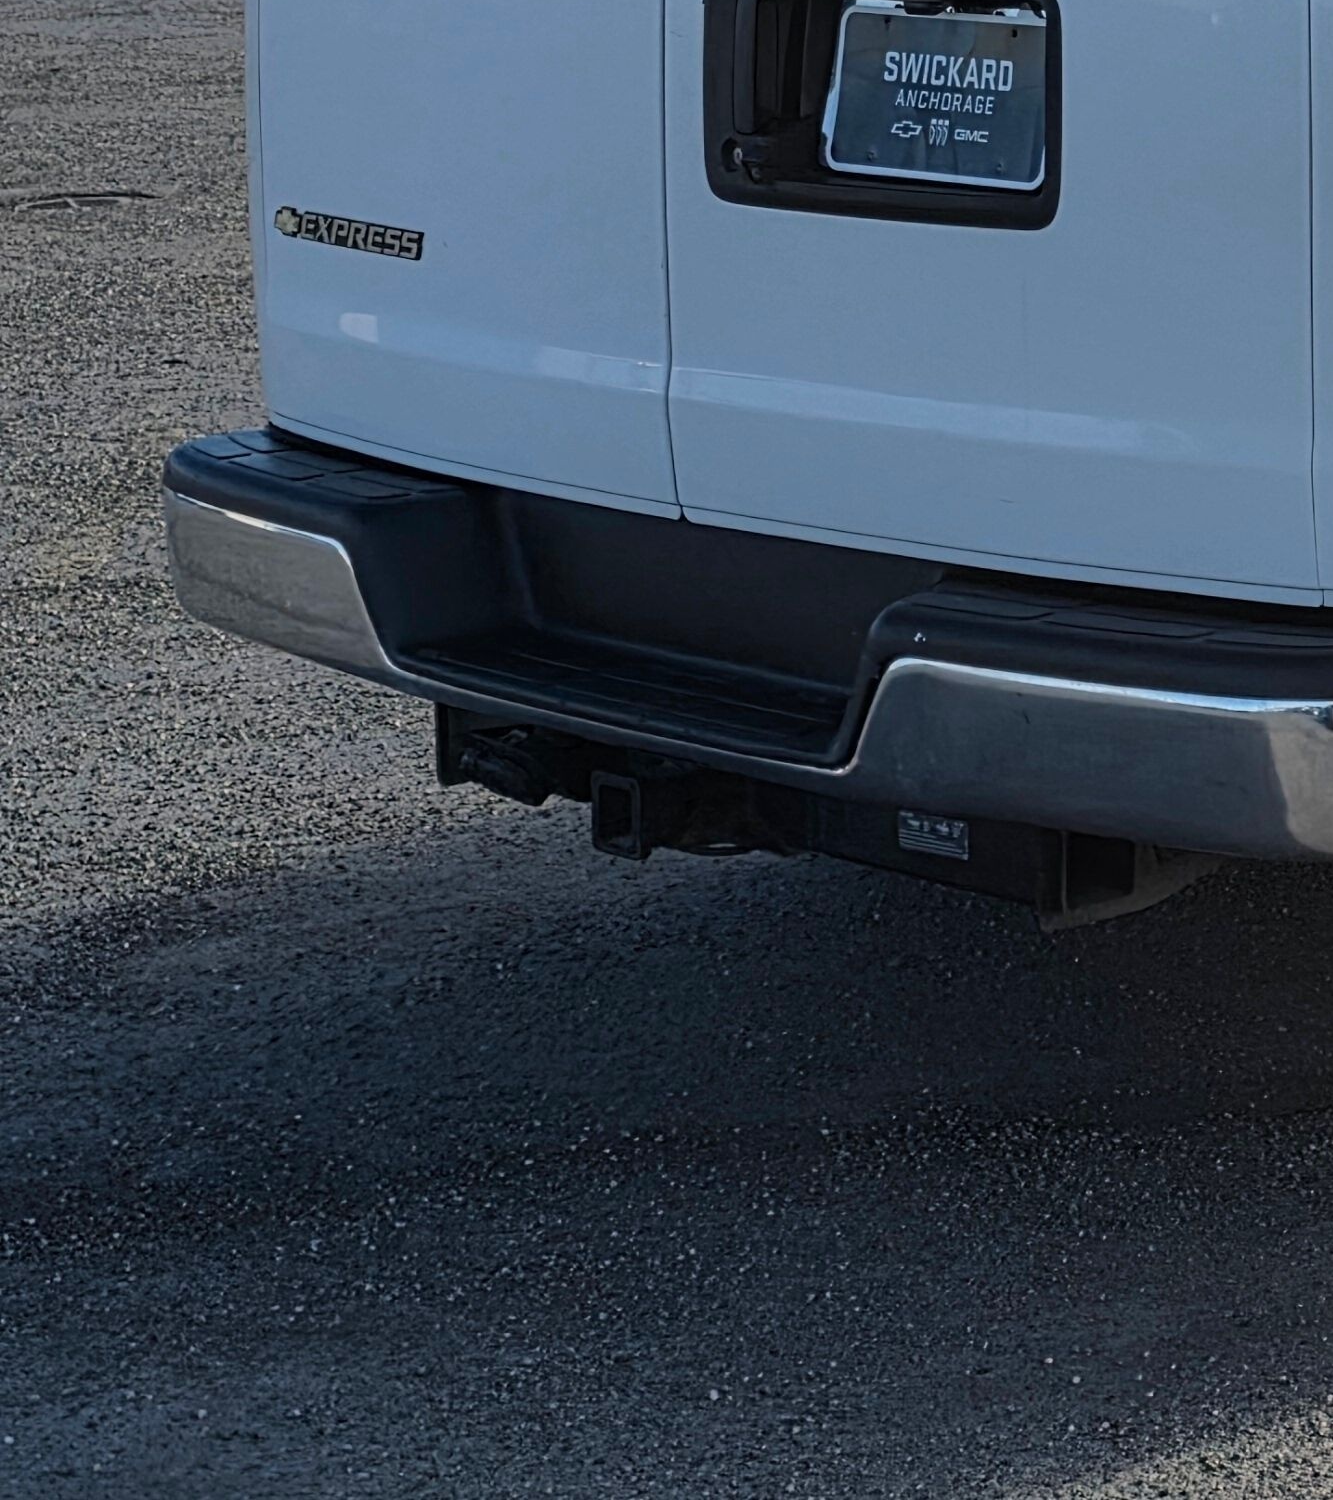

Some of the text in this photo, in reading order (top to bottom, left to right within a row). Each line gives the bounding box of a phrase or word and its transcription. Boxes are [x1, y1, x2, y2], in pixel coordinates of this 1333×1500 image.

[883, 50, 1014, 93] SWICKARD
[894, 88, 995, 116] ANCHORAGE
[954, 128, 989, 144] GMC
[300, 212, 421, 260] EXPRESS
